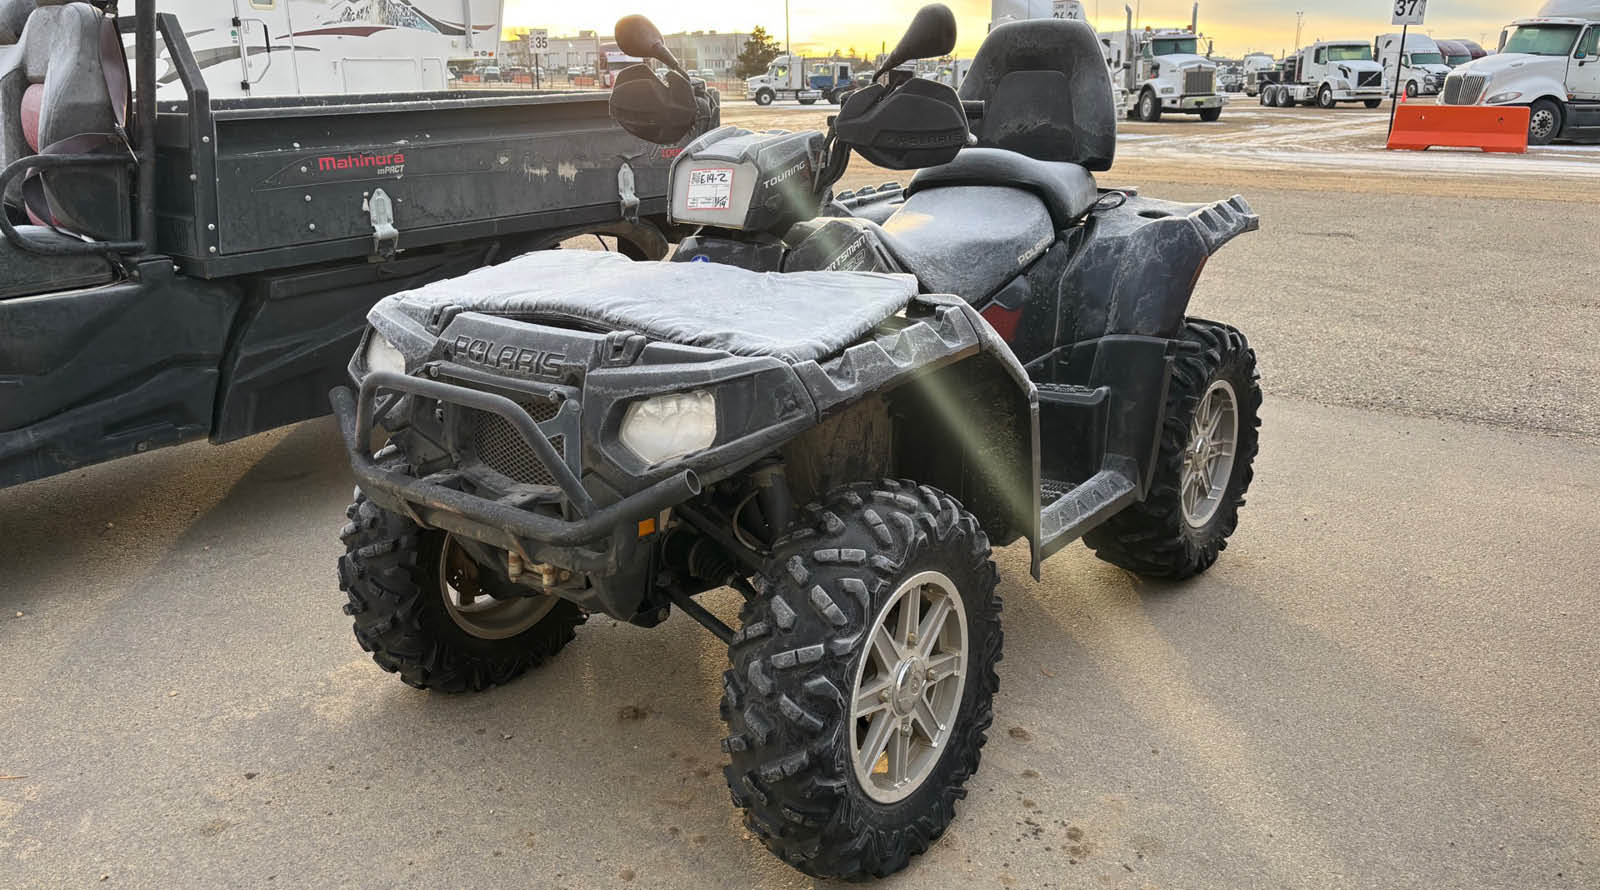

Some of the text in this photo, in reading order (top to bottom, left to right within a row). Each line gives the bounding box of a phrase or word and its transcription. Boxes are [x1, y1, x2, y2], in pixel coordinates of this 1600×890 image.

[1395, 0, 1418, 16] 37
[535, 36, 548, 49] 35
[762, 160, 806, 189] TOURING
[453, 334, 567, 379] POLARIS
